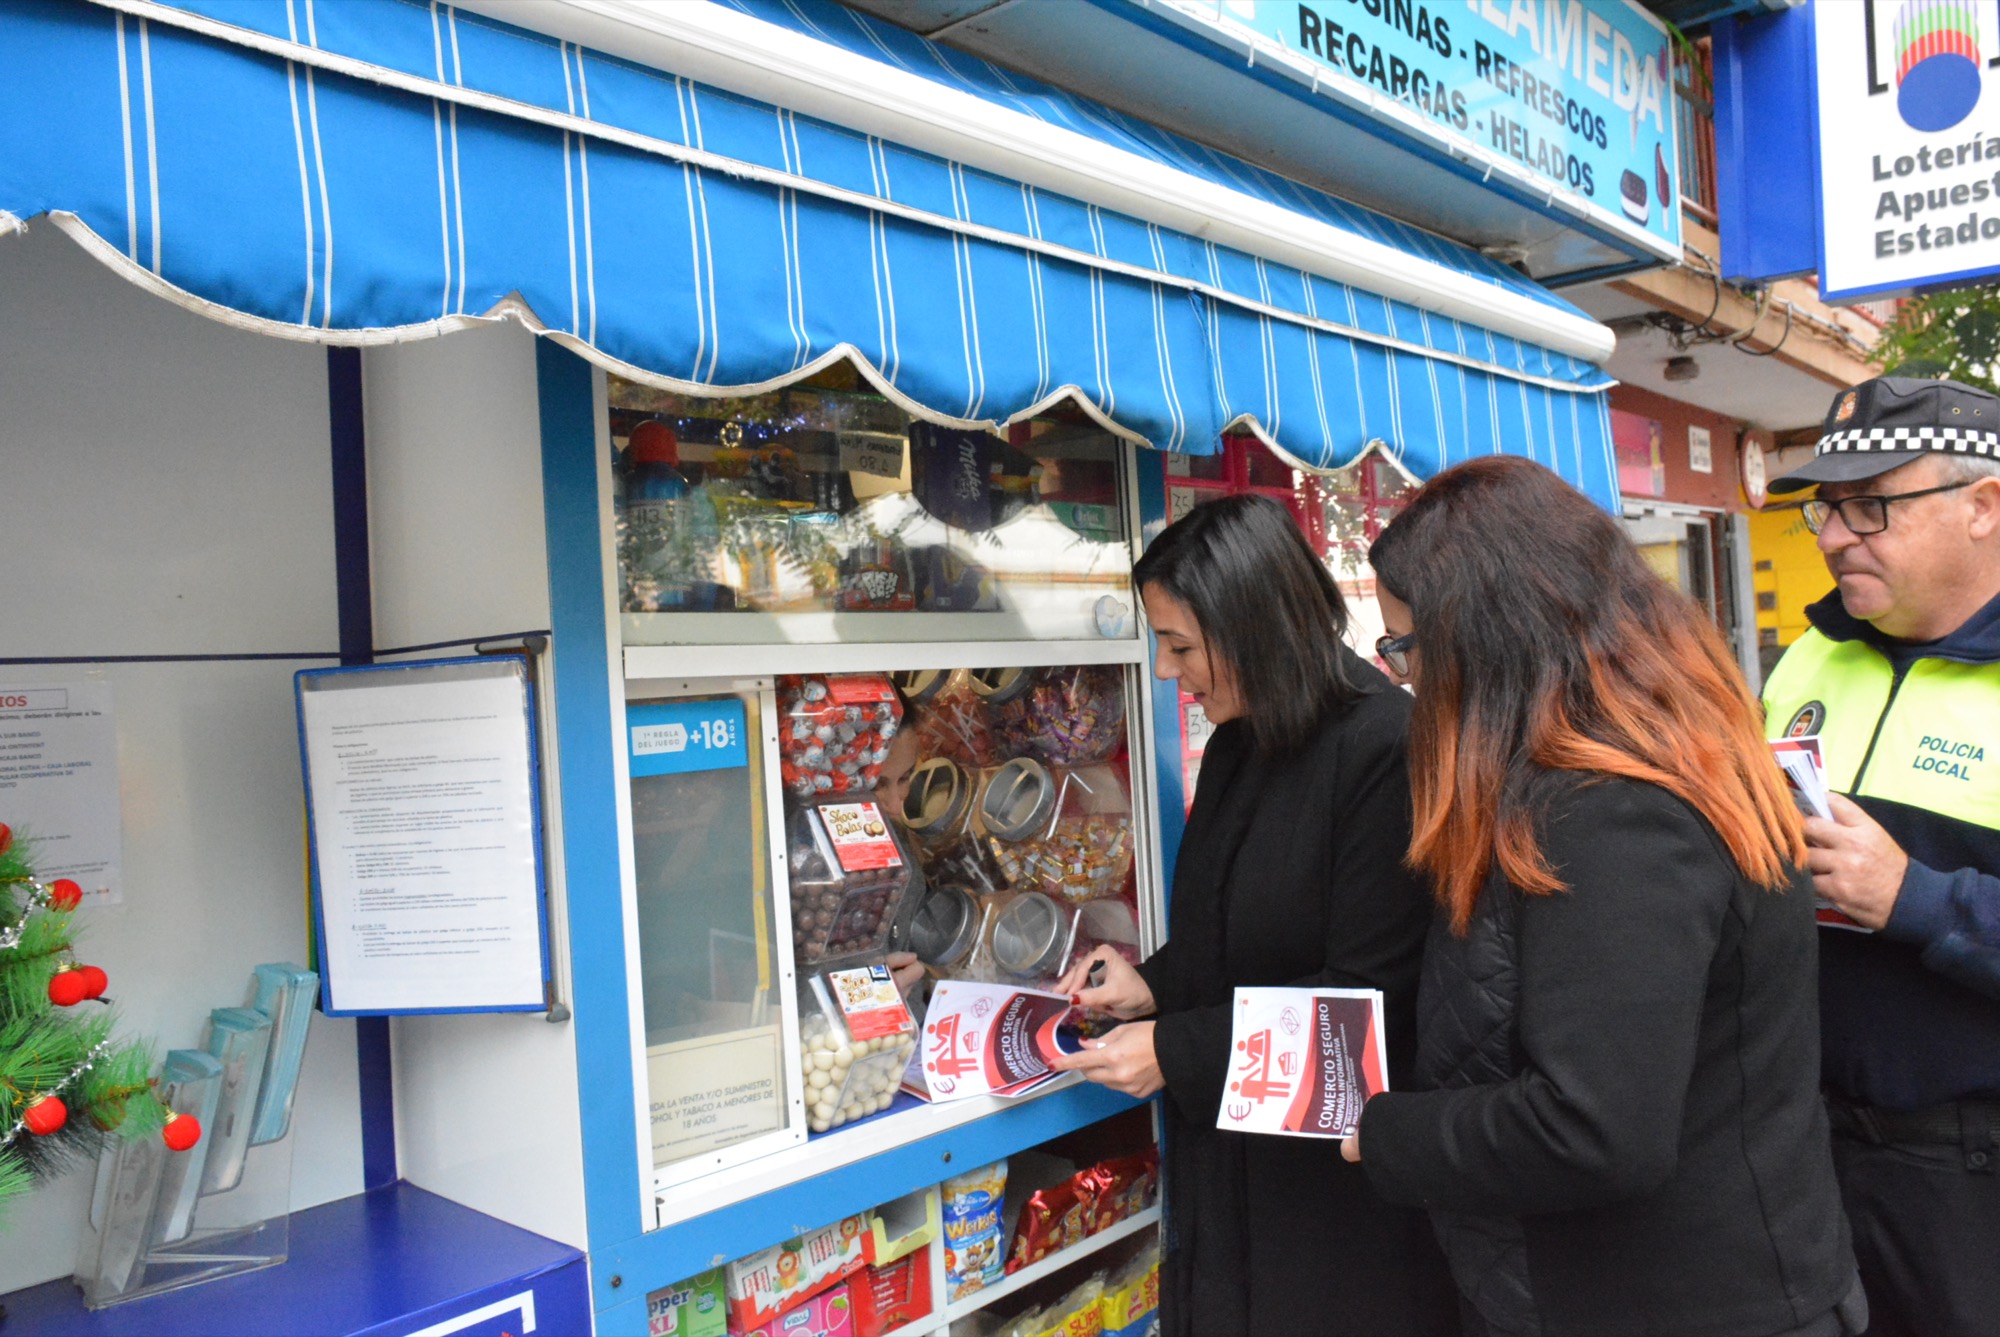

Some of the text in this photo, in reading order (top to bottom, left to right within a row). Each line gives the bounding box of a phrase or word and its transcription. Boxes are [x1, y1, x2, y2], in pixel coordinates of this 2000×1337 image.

[1298, 2, 1595, 197] RECARGAS HELADOS
[1475, 39, 1607, 150] REFRESCOS
[638, 738, 681, 749] DEL JUEGO
[653, 730, 680, 739] REGLA
[690, 719, 729, 750] +18
[728, 718, 737, 746] AÑOS
[1918, 735, 1985, 763] POLICIA
[1912, 755, 1970, 782] LOCAL
[1002, 996, 1026, 1033] SEGURO
[1318, 1003, 1336, 1128] COMERCIO SEGURO
[1332, 1037, 1346, 1130] CAMPAÑA INFORMATIVA
